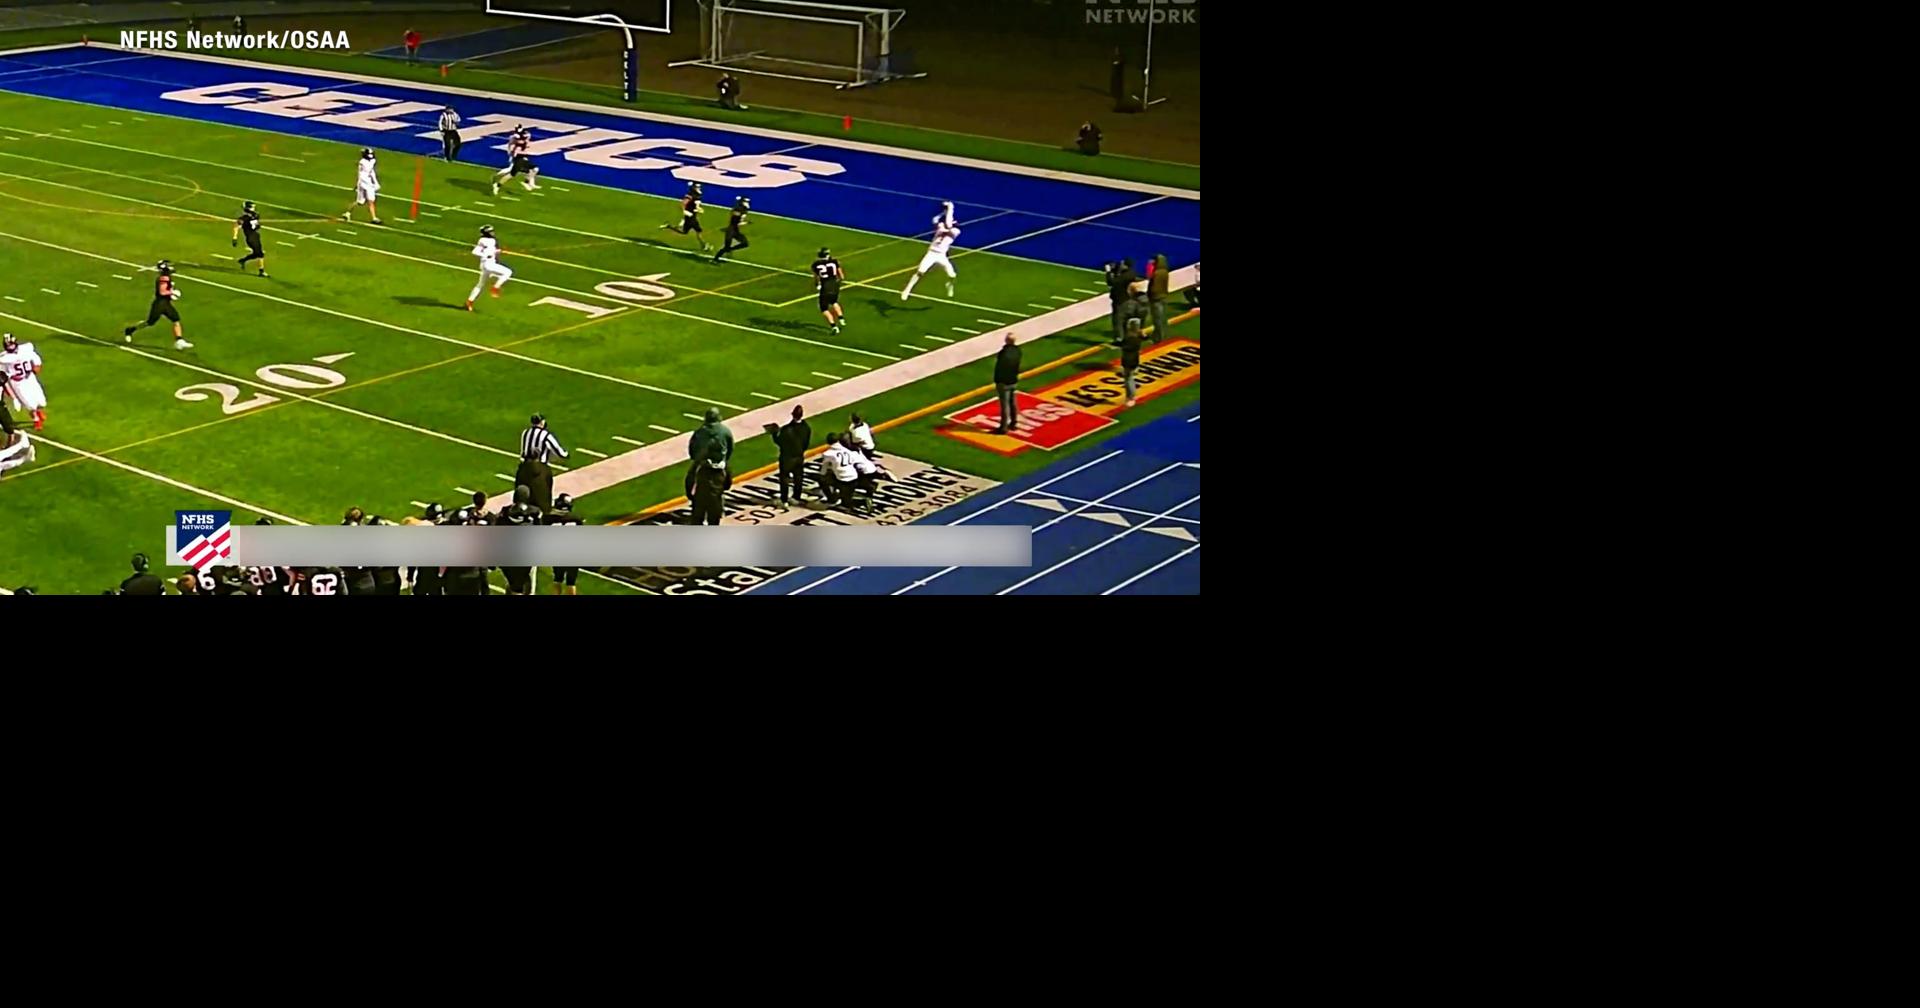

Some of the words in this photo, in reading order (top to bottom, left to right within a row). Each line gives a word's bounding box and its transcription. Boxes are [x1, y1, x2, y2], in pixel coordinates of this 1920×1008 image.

[160, 82, 846, 188] CELTICS
[816, 262, 837, 278] 27
[528, 280, 675, 319] 10
[175, 363, 346, 415] 20
